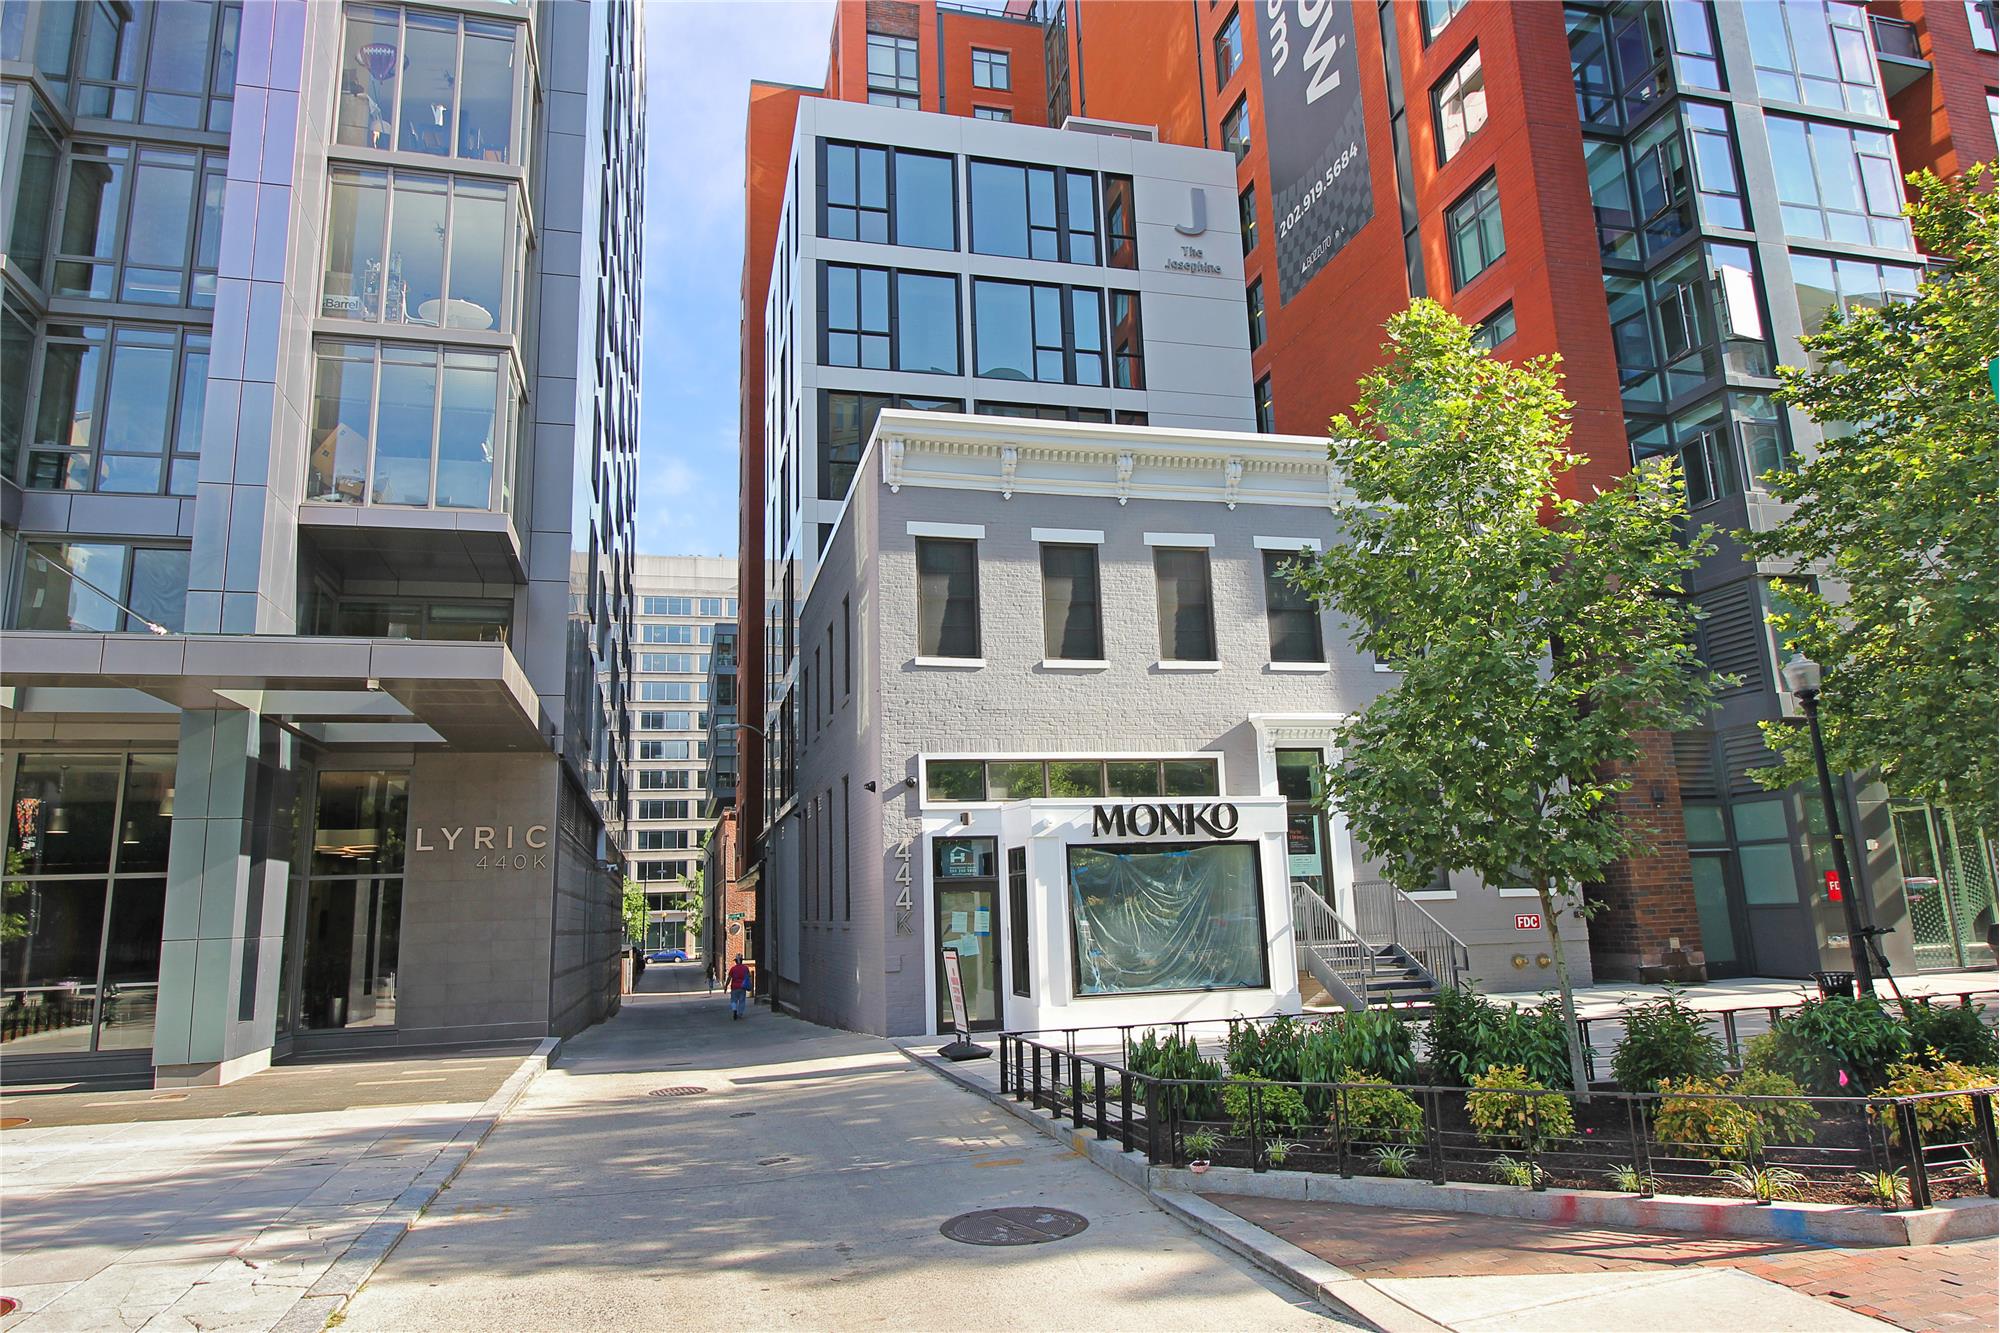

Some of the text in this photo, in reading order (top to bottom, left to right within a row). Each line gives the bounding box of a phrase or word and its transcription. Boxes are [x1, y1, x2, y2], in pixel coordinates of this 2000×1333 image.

[1280, 141, 1358, 239] 202.919.5684
[1181, 245, 1203, 258] The
[1165, 258, 1222, 274] Josephine
[323, 298, 359, 309] Barrel
[1092, 803, 1239, 839] MONKO
[416, 825, 548, 852] LYRIC
[476, 854, 547, 871] 440K
[1517, 916, 1538, 928] FDC
